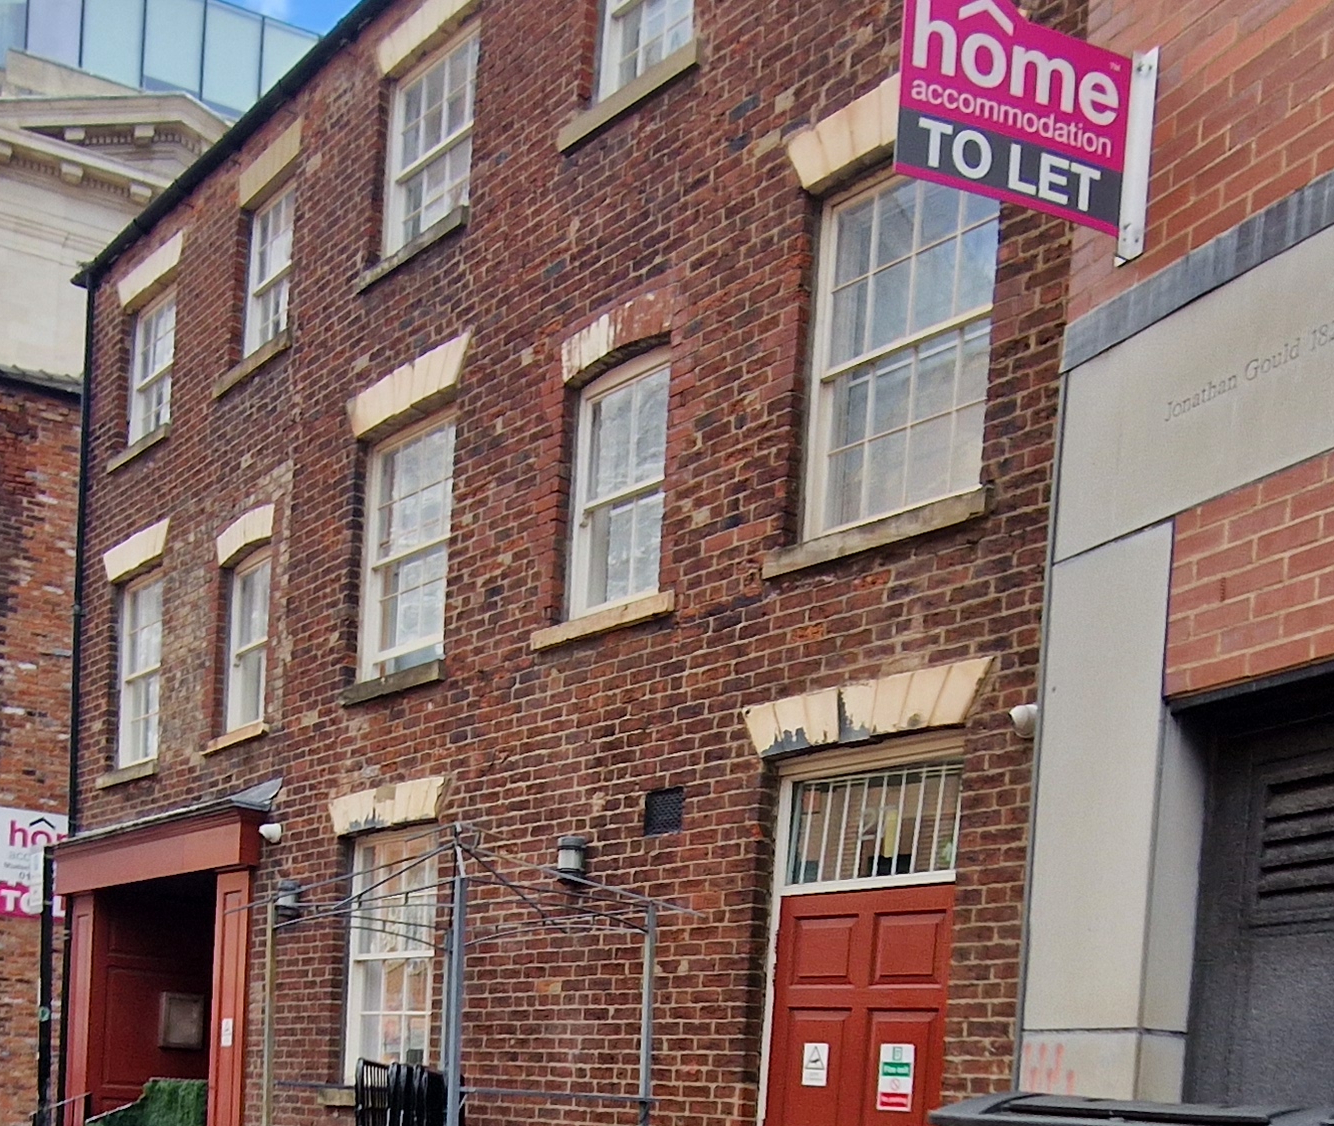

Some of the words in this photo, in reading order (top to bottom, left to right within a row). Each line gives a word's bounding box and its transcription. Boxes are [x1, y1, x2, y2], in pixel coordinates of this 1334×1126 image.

[912, 0, 1119, 126] home
[911, 79, 1111, 158] accommodation
[918, 117, 992, 180] TO
[1007, 143, 1101, 212] LET
[1164, 373, 1238, 422] Jonathan
[1244, 337, 1302, 381] Gould
